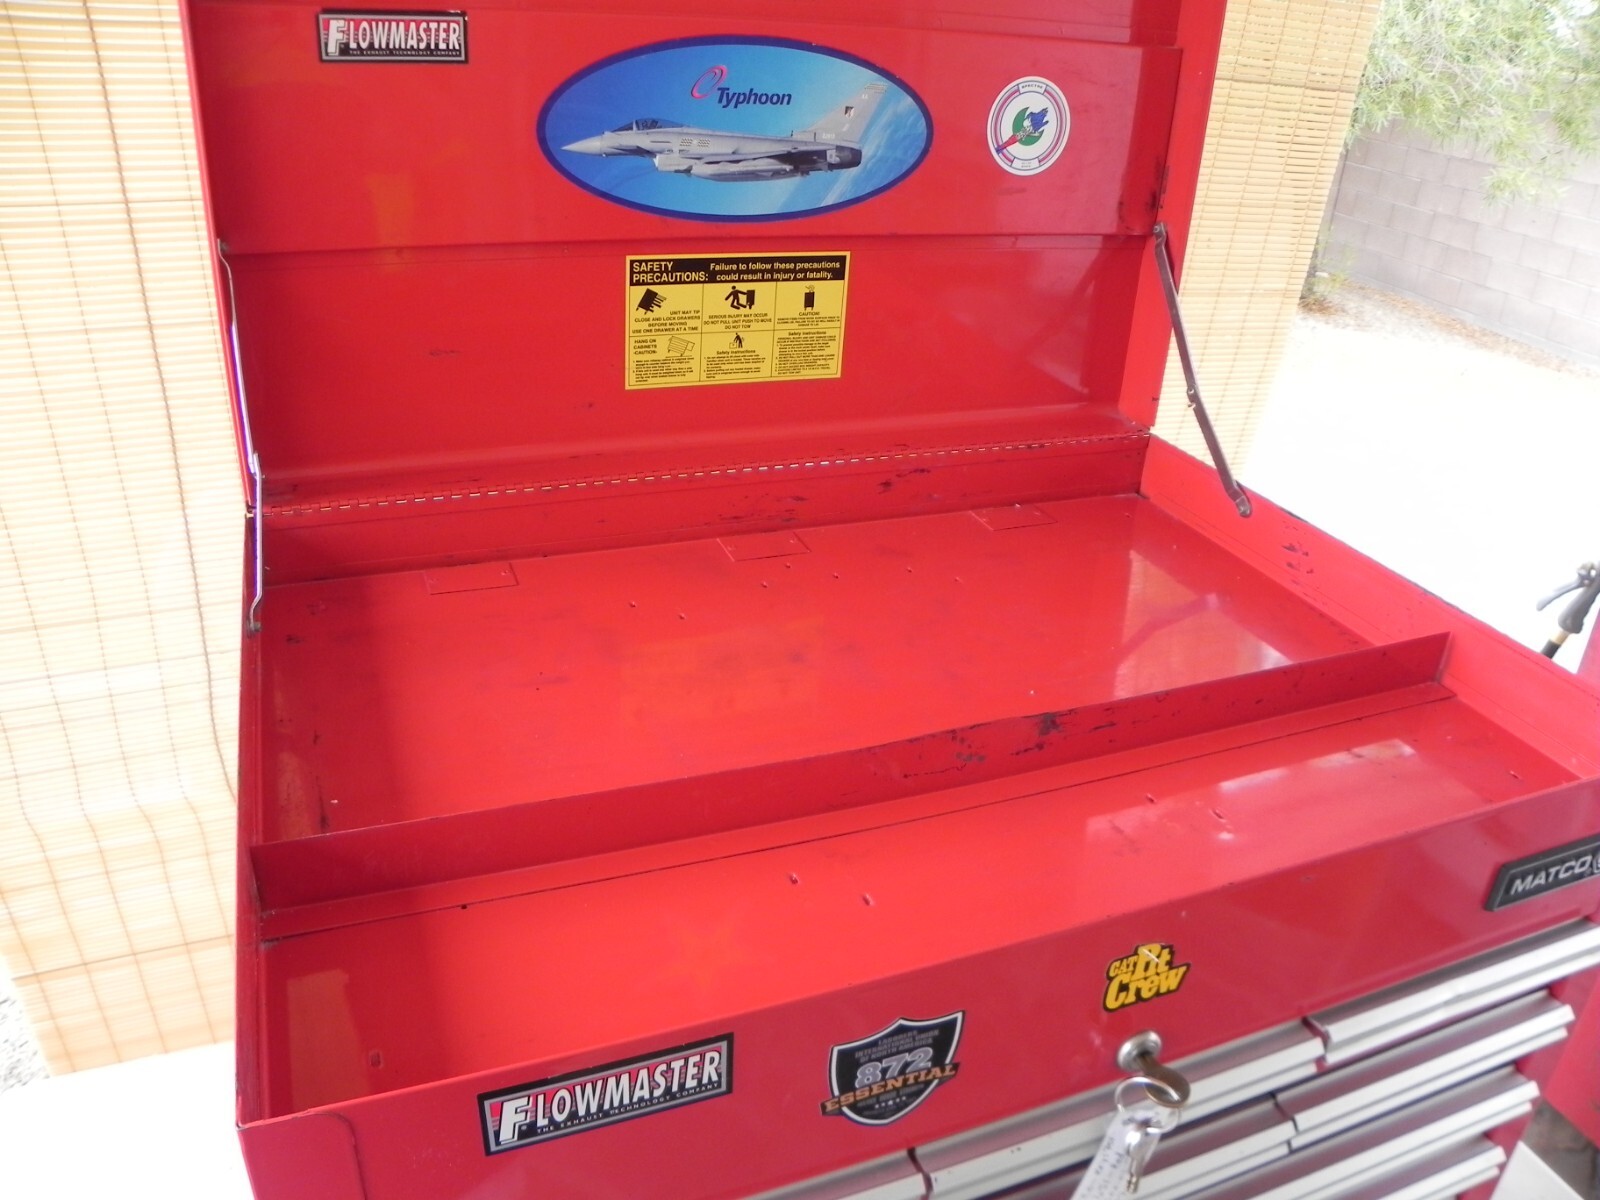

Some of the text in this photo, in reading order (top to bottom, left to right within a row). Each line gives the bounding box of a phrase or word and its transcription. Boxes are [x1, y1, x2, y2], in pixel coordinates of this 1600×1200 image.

[327, 19, 460, 56] FLOWMASTER
[717, 87, 792, 109] Typhoon
[633, 261, 674, 272] SAFETY
[633, 271, 709, 283] PRECAUTIONS:
[710, 261, 840, 271] Failure to follow these precautions
[716, 272, 738, 281] could
[740, 272, 762, 280] result
[763, 271, 771, 279] in
[773, 271, 795, 281] injury
[806, 271, 833, 279] fatality.
[1509, 854, 1593, 896] MATCO
[1105, 965, 1188, 1010] Crew
[855, 1046, 934, 1090] 872
[498, 1050, 721, 1145] FLOWMASTER
[823, 1064, 957, 1113] ESSENTIAL
[537, 1083, 719, 1134] THE EXHAUST TECHNOLOGY COMPANY
